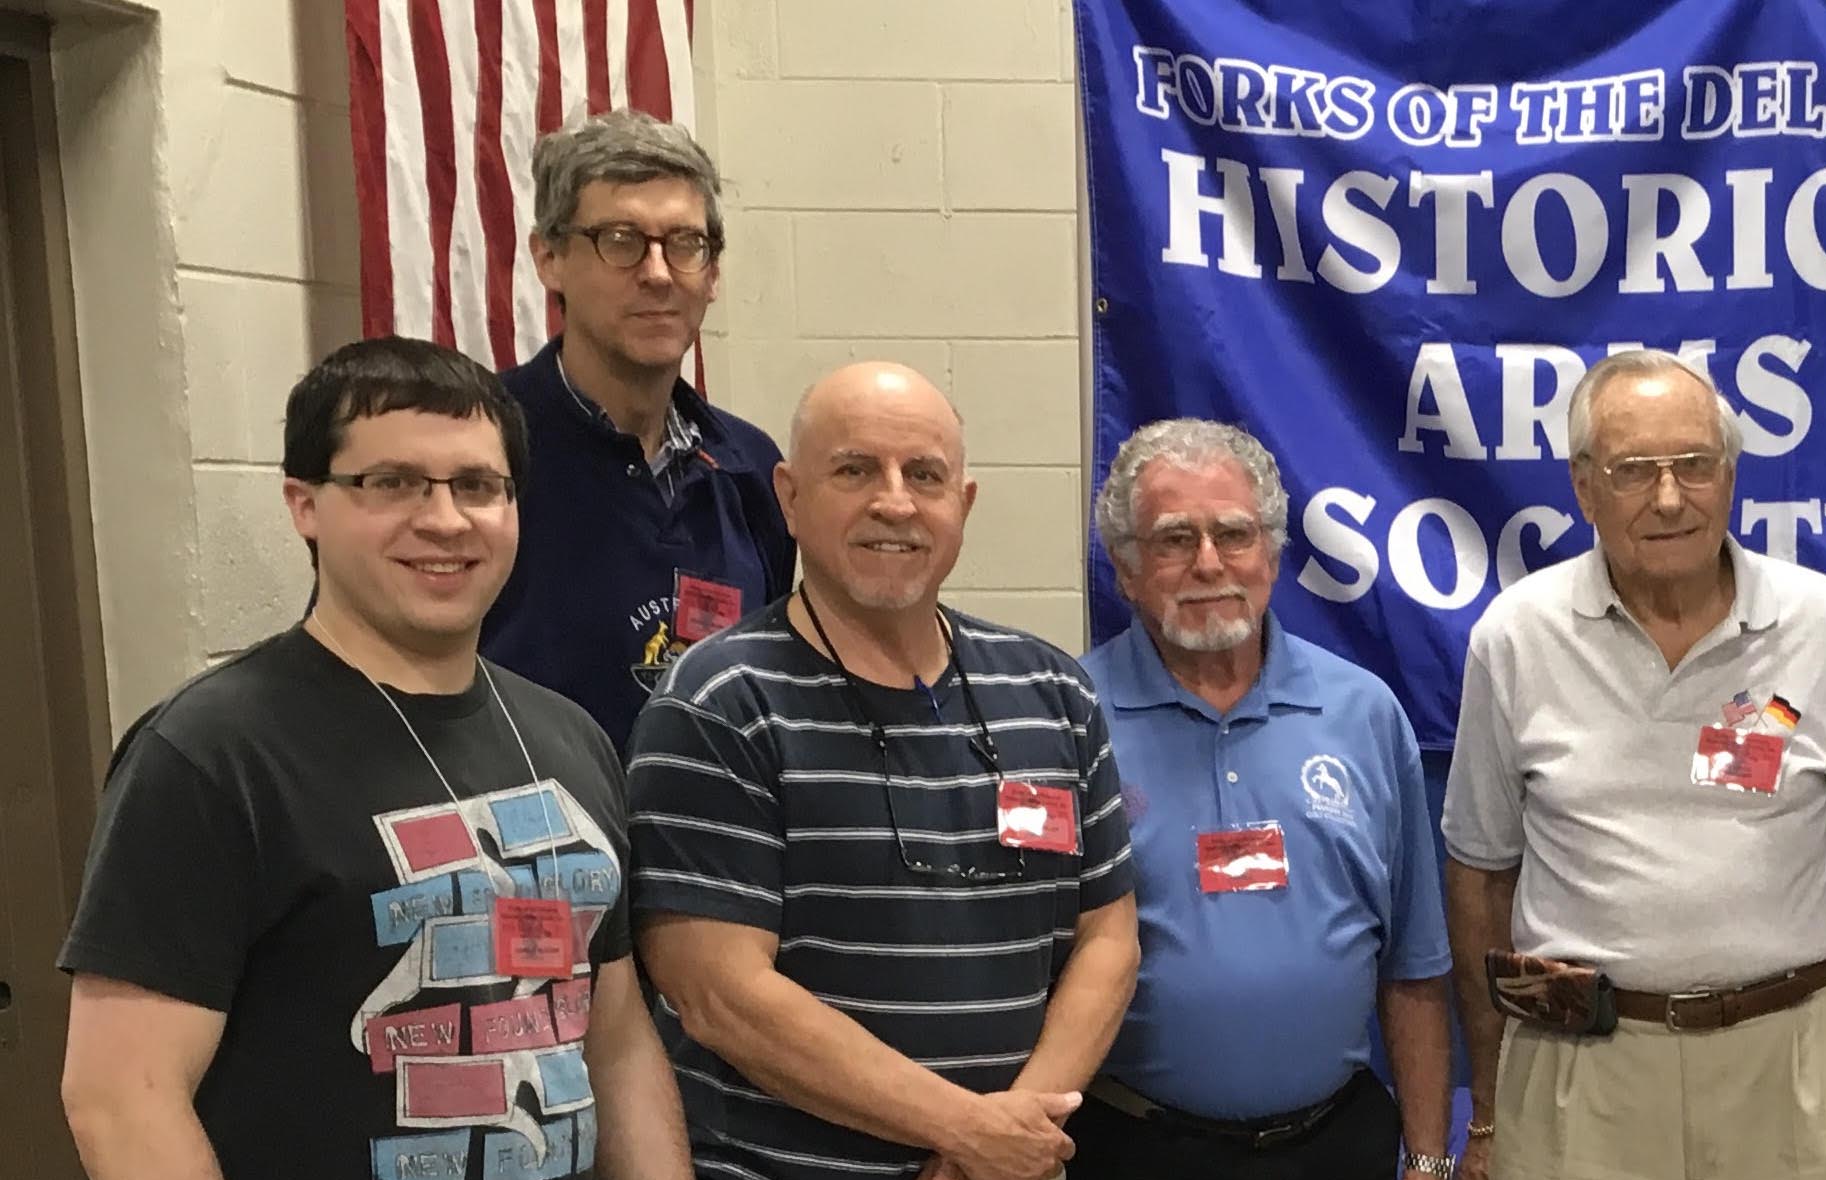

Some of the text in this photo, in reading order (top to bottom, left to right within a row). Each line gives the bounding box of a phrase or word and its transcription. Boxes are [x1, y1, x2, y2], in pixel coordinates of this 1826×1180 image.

[1133, 46, 1375, 139] FORKS
[1388, 84, 1497, 148] OF
[1510, 69, 1666, 145] THE
[1397, 334, 1813, 461] ARS
[383, 1021, 453, 1051] NEW
